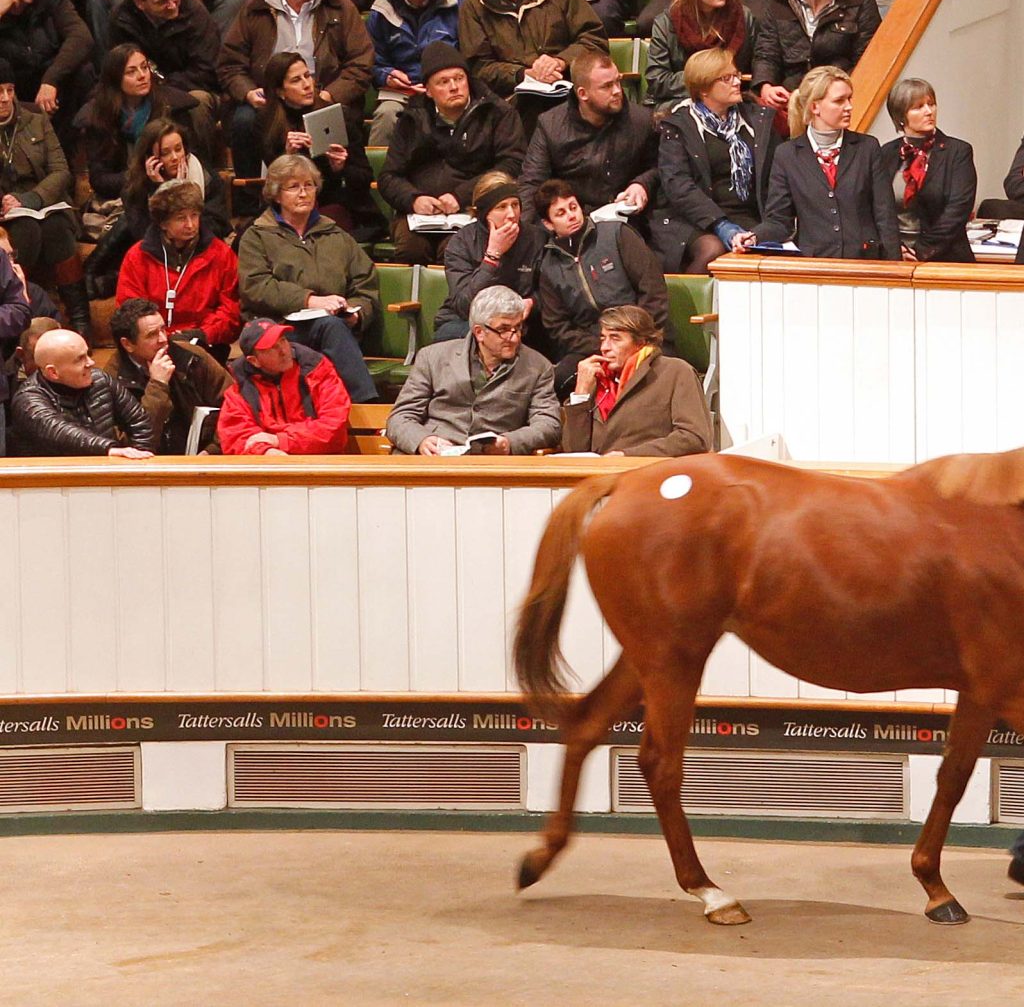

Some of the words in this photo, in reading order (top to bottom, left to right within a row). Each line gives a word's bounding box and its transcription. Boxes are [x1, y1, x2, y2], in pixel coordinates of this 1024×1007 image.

[66, 715, 154, 731] Millions
[178, 712, 264, 729] Tattersalls
[269, 712, 356, 729] Millions
[382, 713, 467, 729] Tattersalls
[783, 721, 867, 739] Tattersalls
[874, 723, 950, 742] Million
